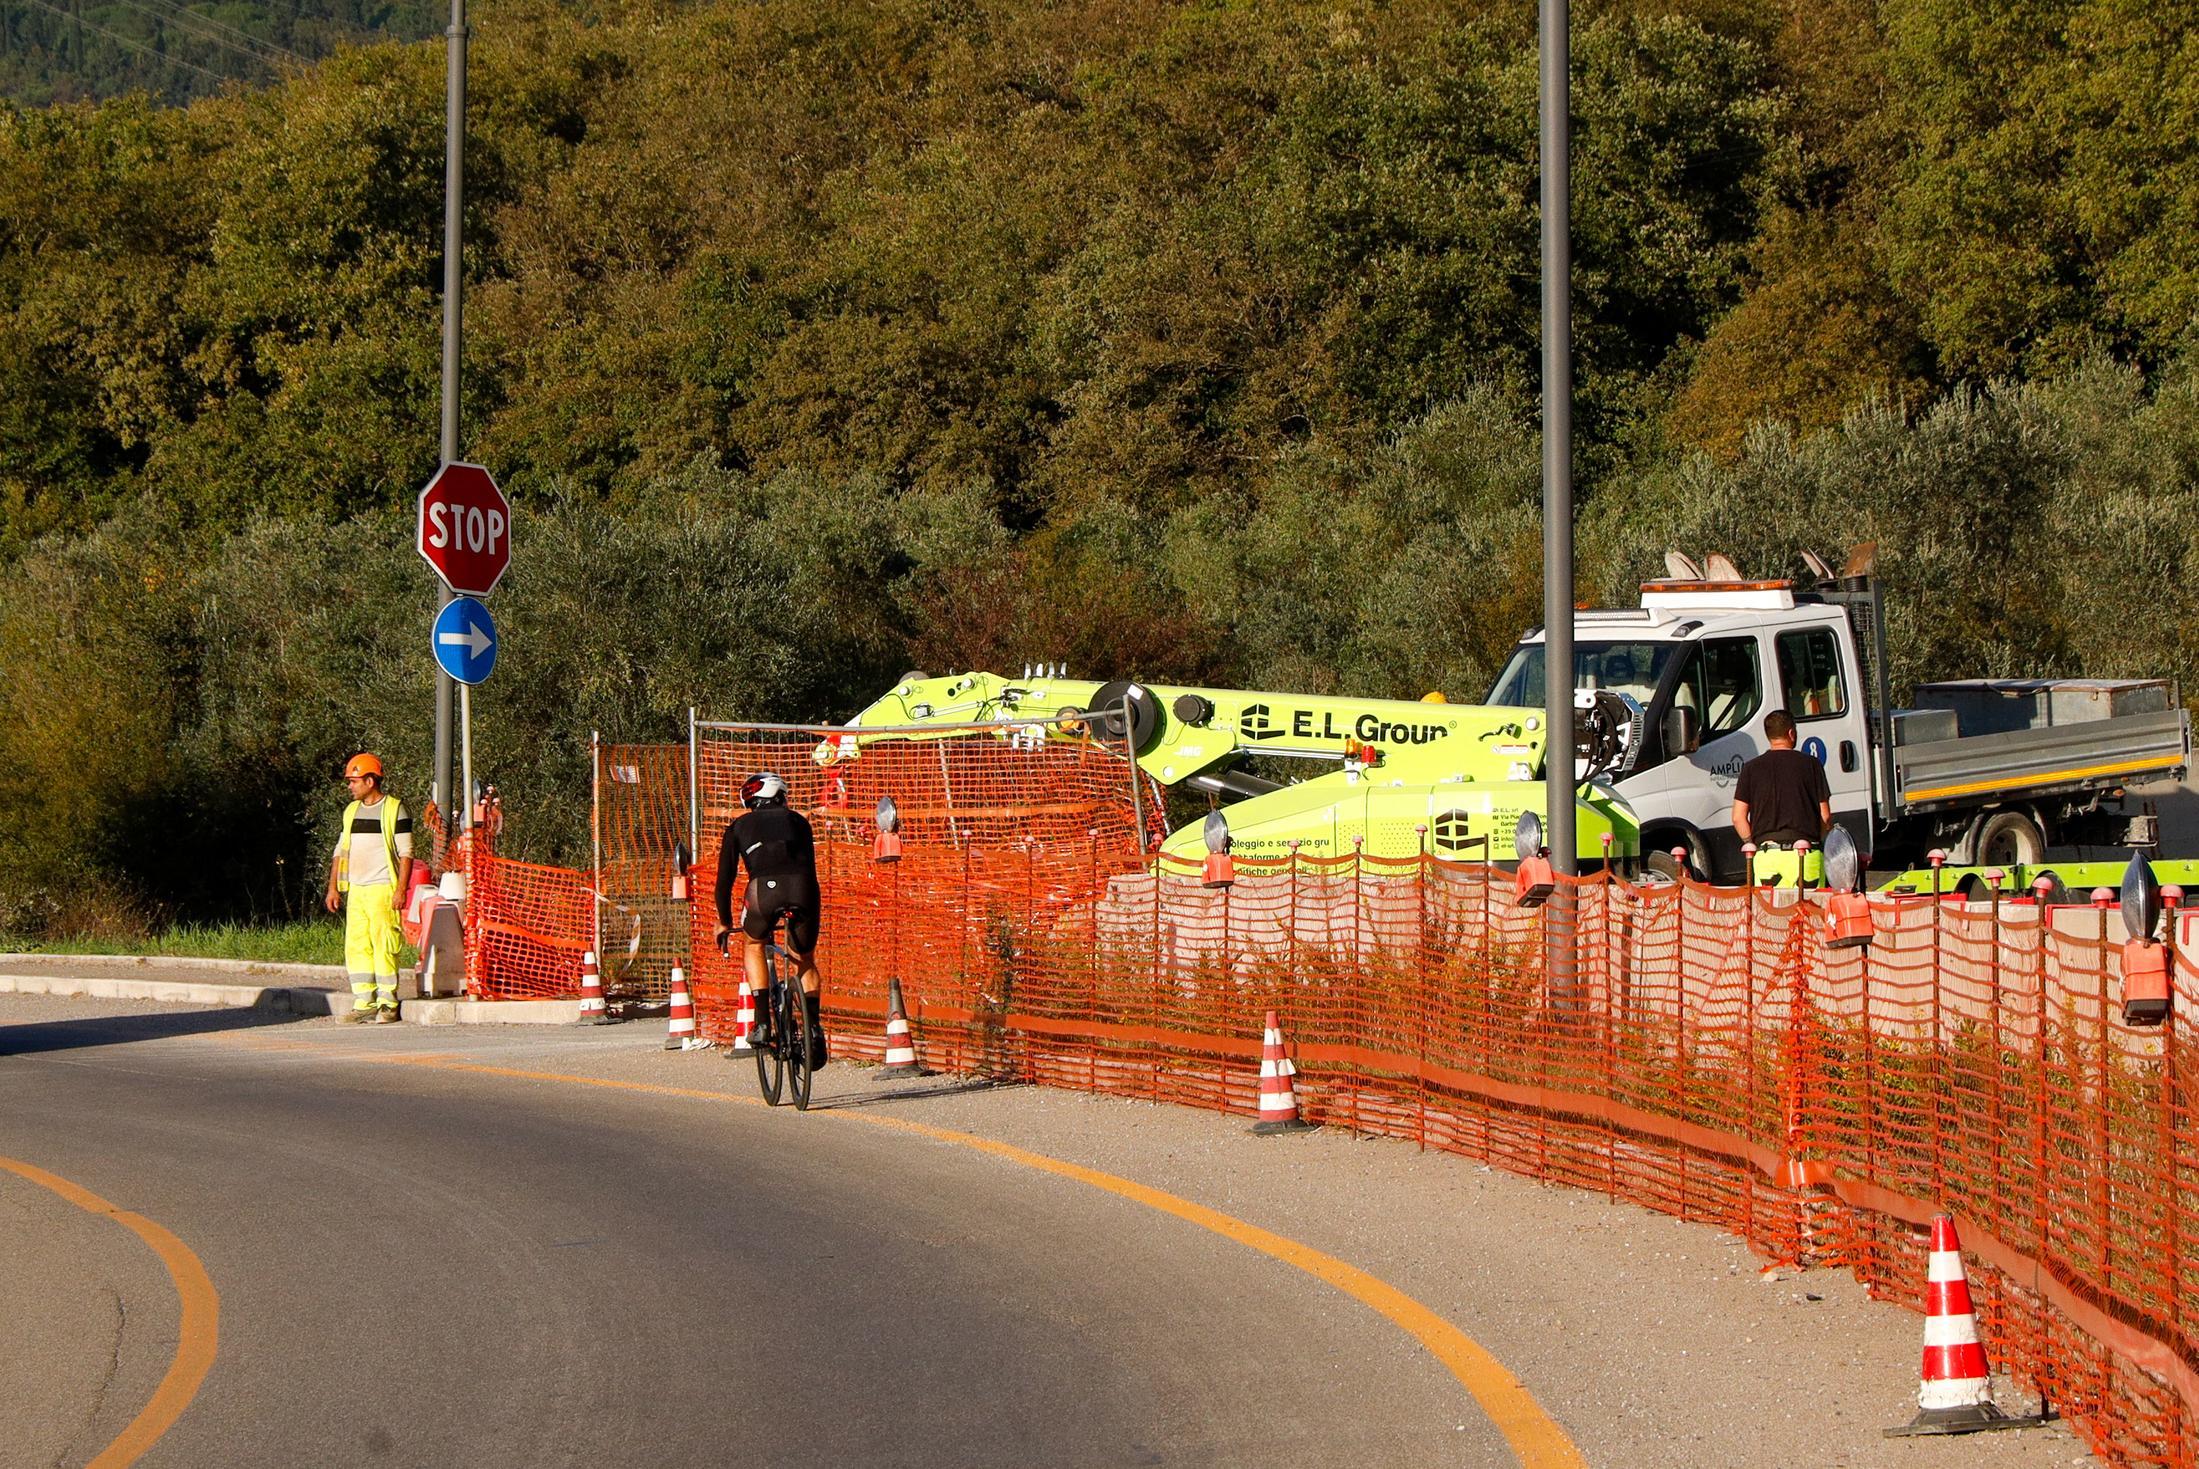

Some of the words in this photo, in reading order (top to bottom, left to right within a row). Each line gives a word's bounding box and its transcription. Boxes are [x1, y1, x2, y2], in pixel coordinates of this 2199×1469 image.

[429, 501, 505, 555] STOP
[1231, 839, 1265, 850] oleggio
[1314, 838, 1330, 849] gru
